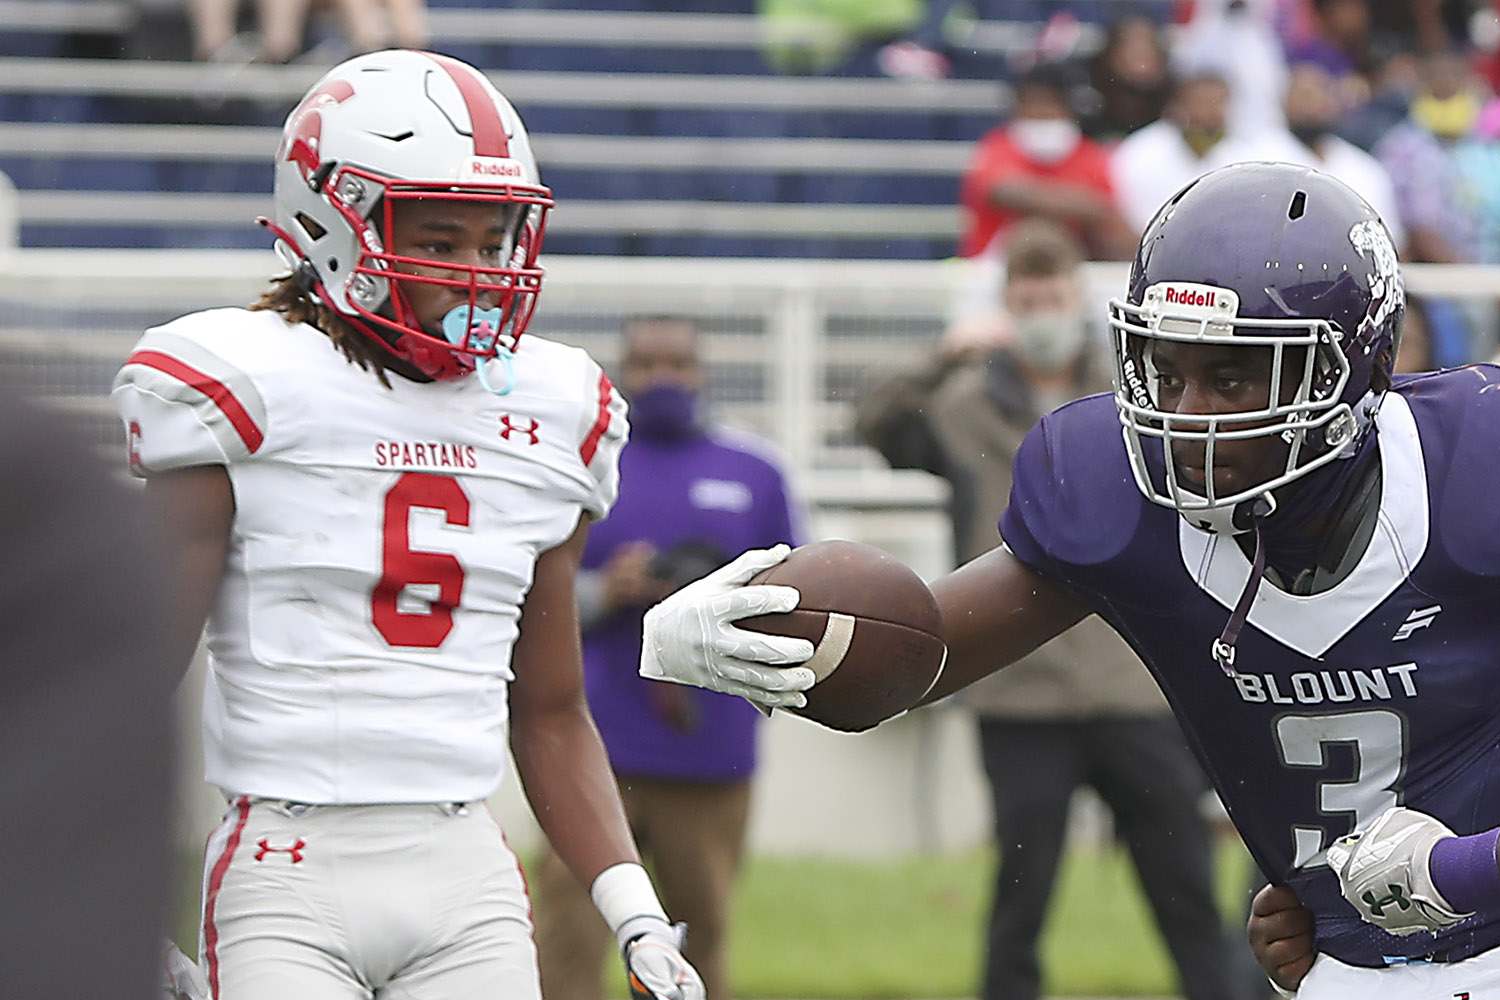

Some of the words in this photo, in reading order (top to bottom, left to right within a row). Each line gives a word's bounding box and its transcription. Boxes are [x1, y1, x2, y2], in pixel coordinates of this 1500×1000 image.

[1165, 287, 1215, 307] Riddell
[376, 442, 477, 468] SPARTANS
[368, 471, 472, 650] 6
[1235, 662, 1418, 704] BLOUNT
[1272, 706, 1408, 870] 3
